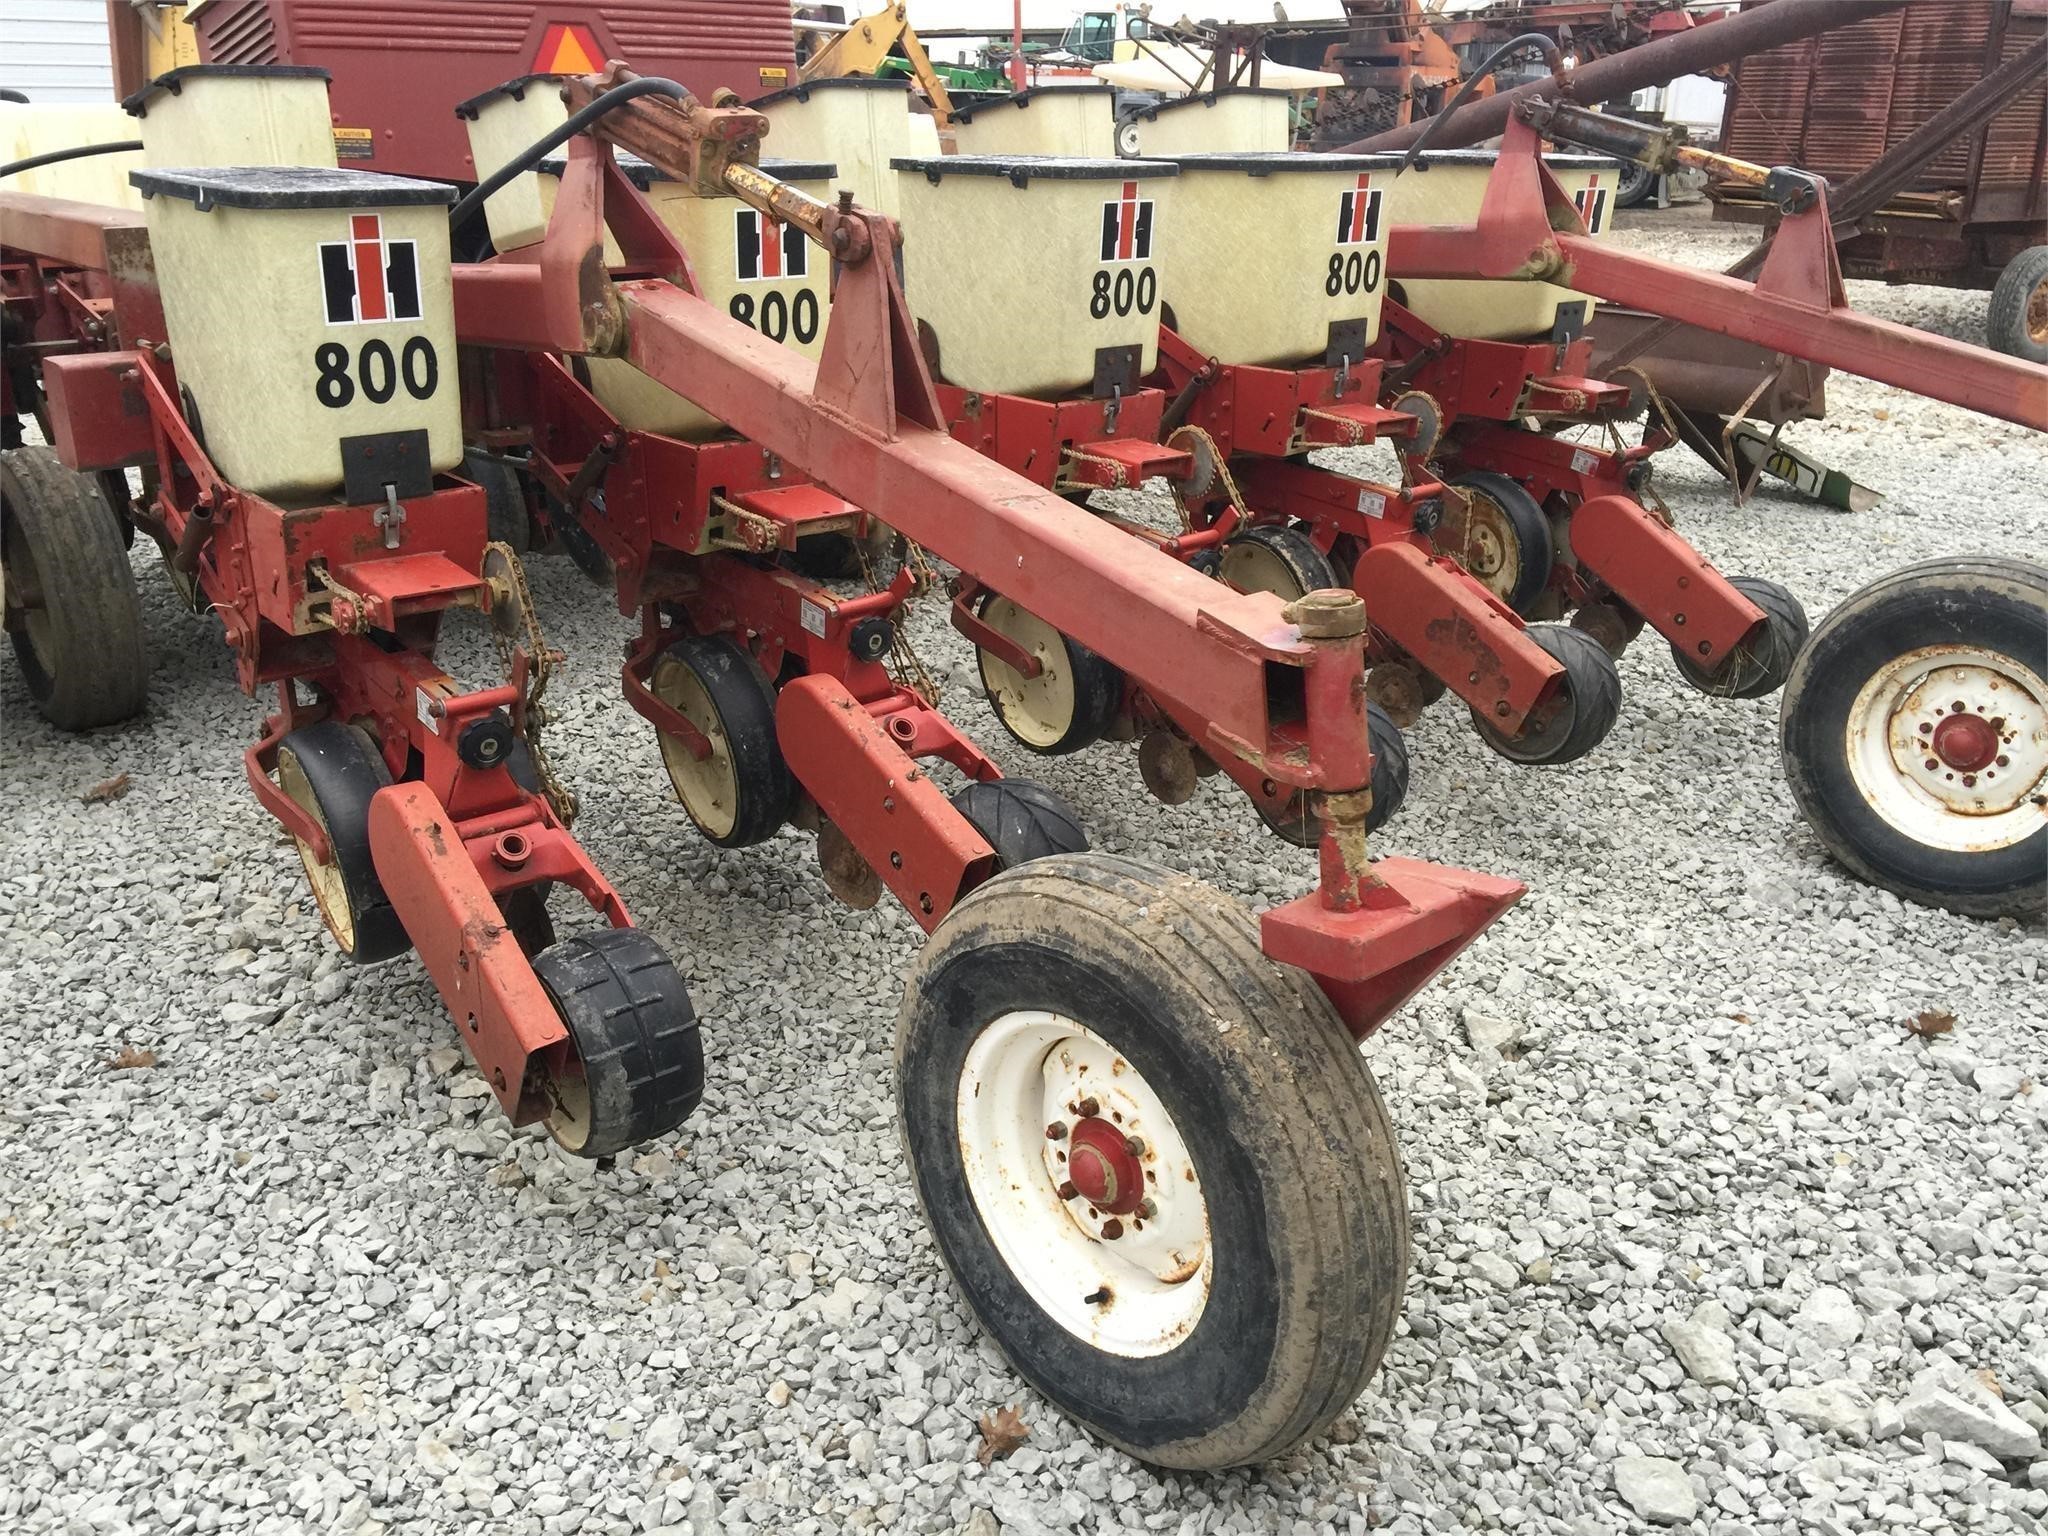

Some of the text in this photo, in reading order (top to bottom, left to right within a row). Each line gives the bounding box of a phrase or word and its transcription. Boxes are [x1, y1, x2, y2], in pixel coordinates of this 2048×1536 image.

[1090, 266, 1156, 320] 800
[1326, 249, 1381, 297] 800
[314, 335, 439, 409] 800
